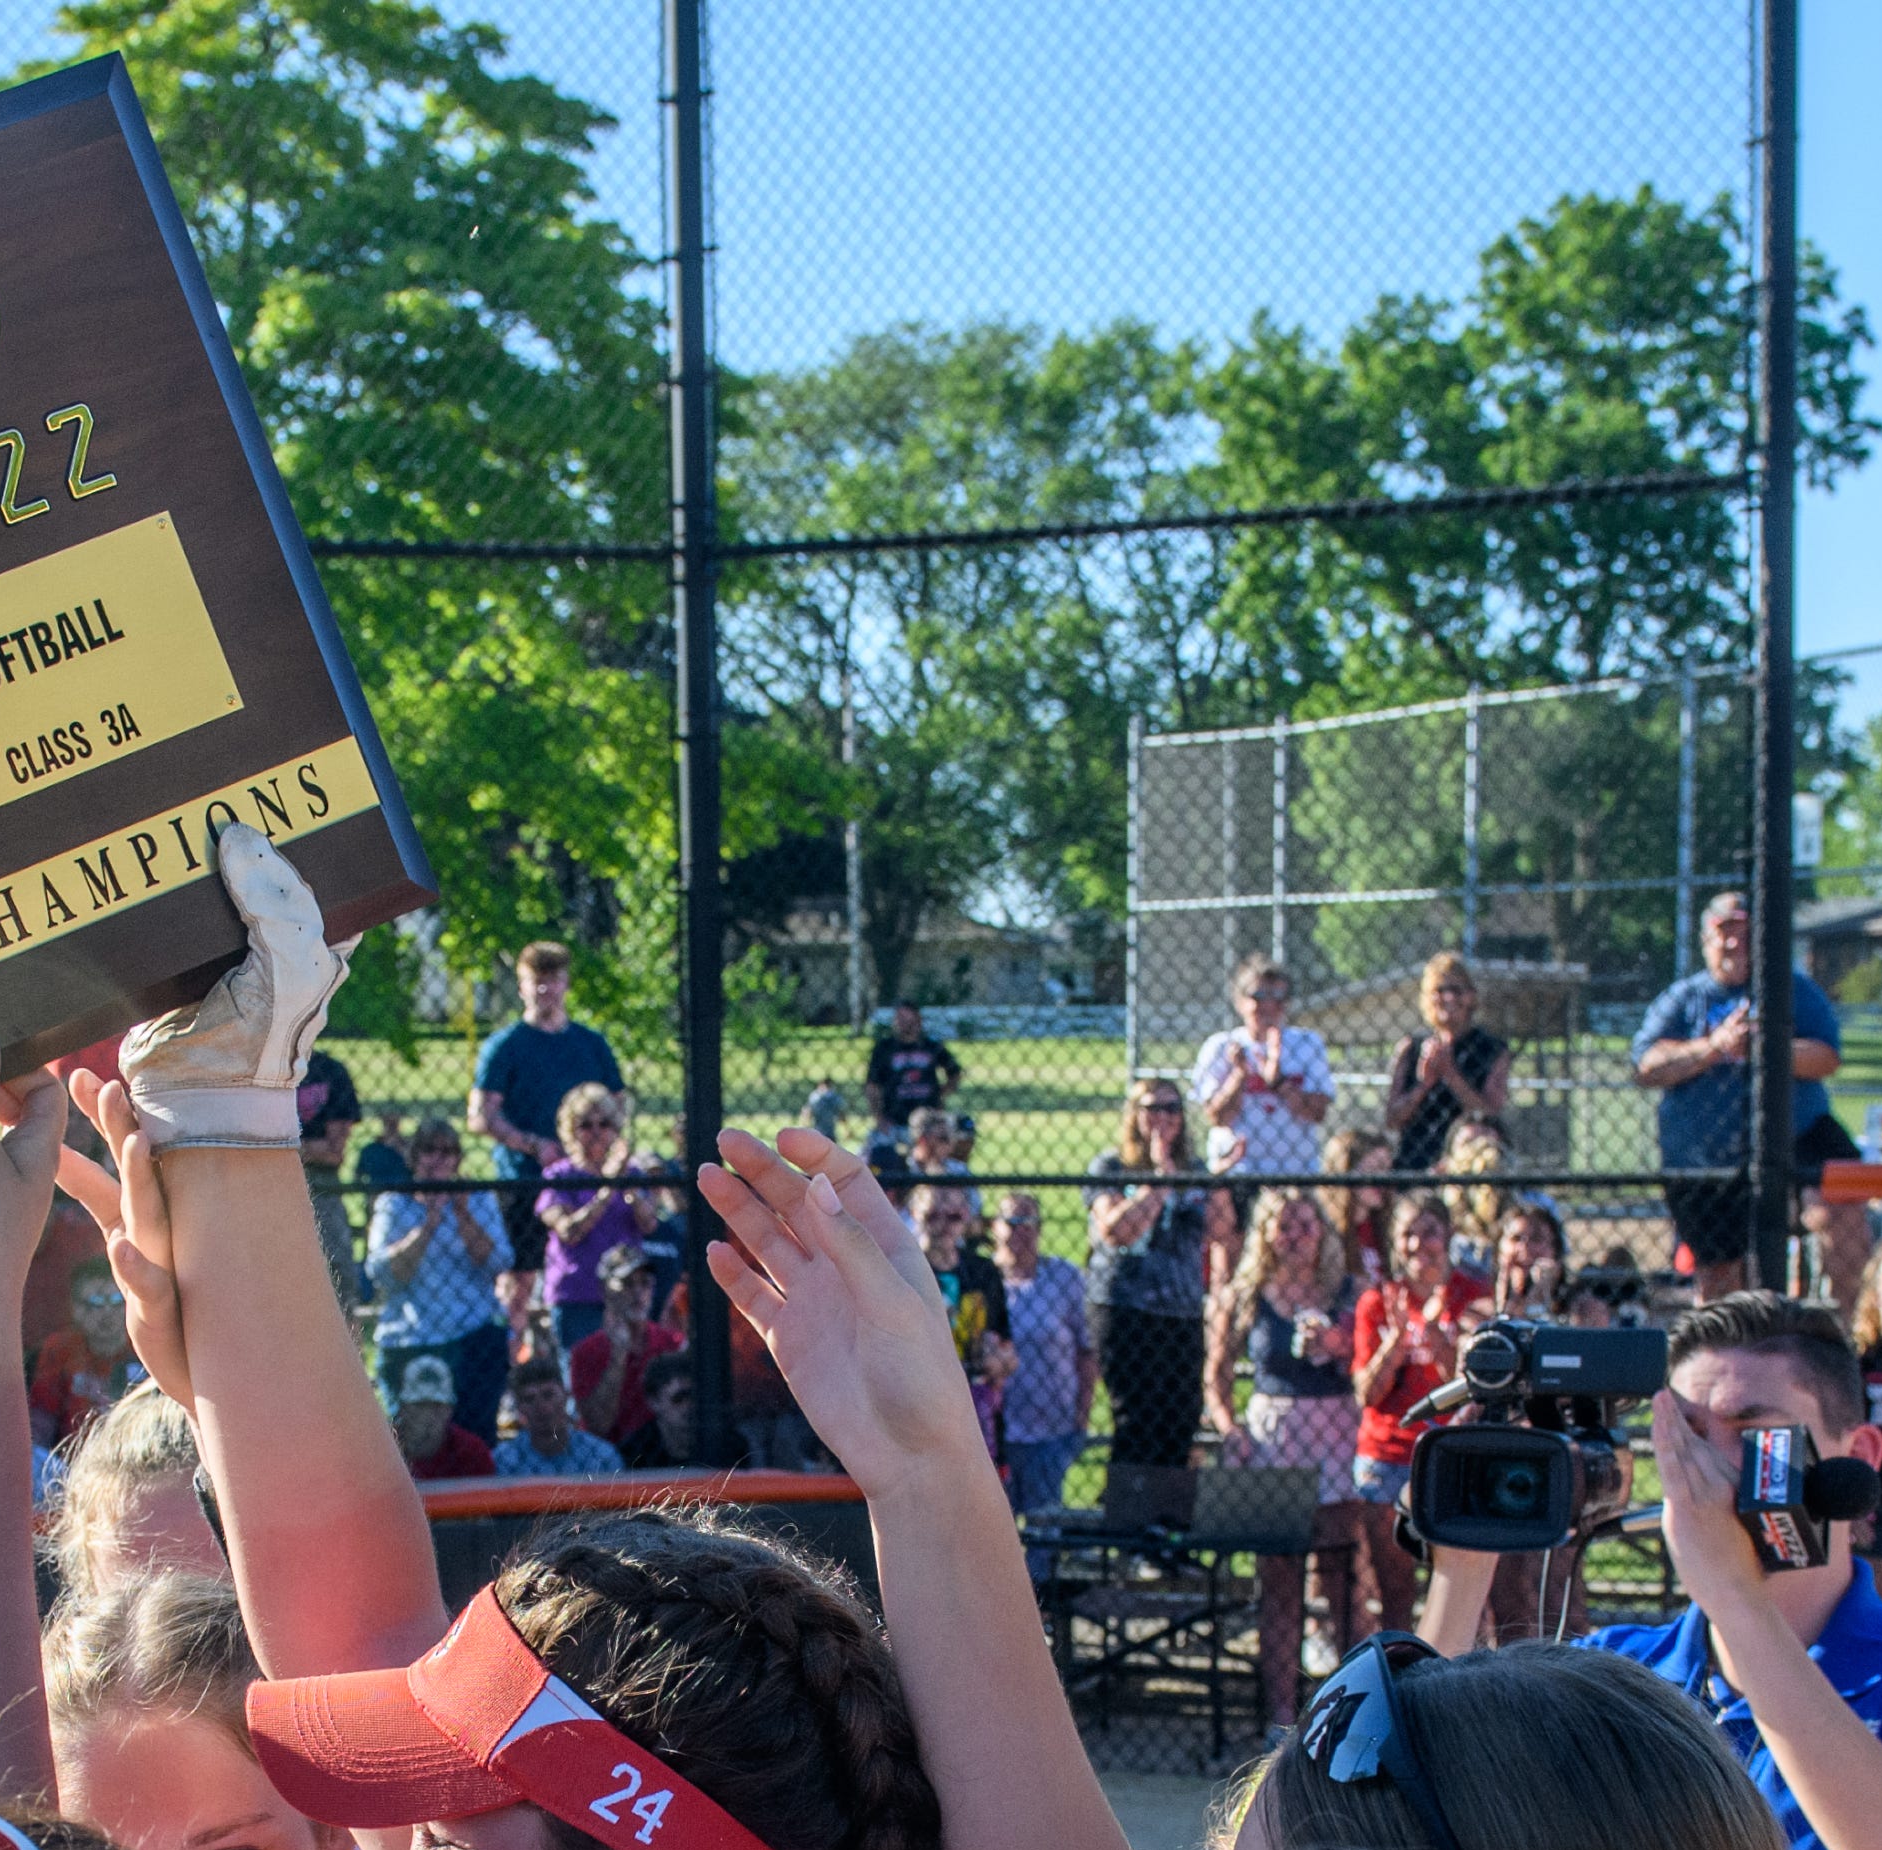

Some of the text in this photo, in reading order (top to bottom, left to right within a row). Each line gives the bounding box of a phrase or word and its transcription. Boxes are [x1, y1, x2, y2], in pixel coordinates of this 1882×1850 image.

[5, 702, 142, 785] CLASS 3A
[589, 1762, 675, 1845] 24
